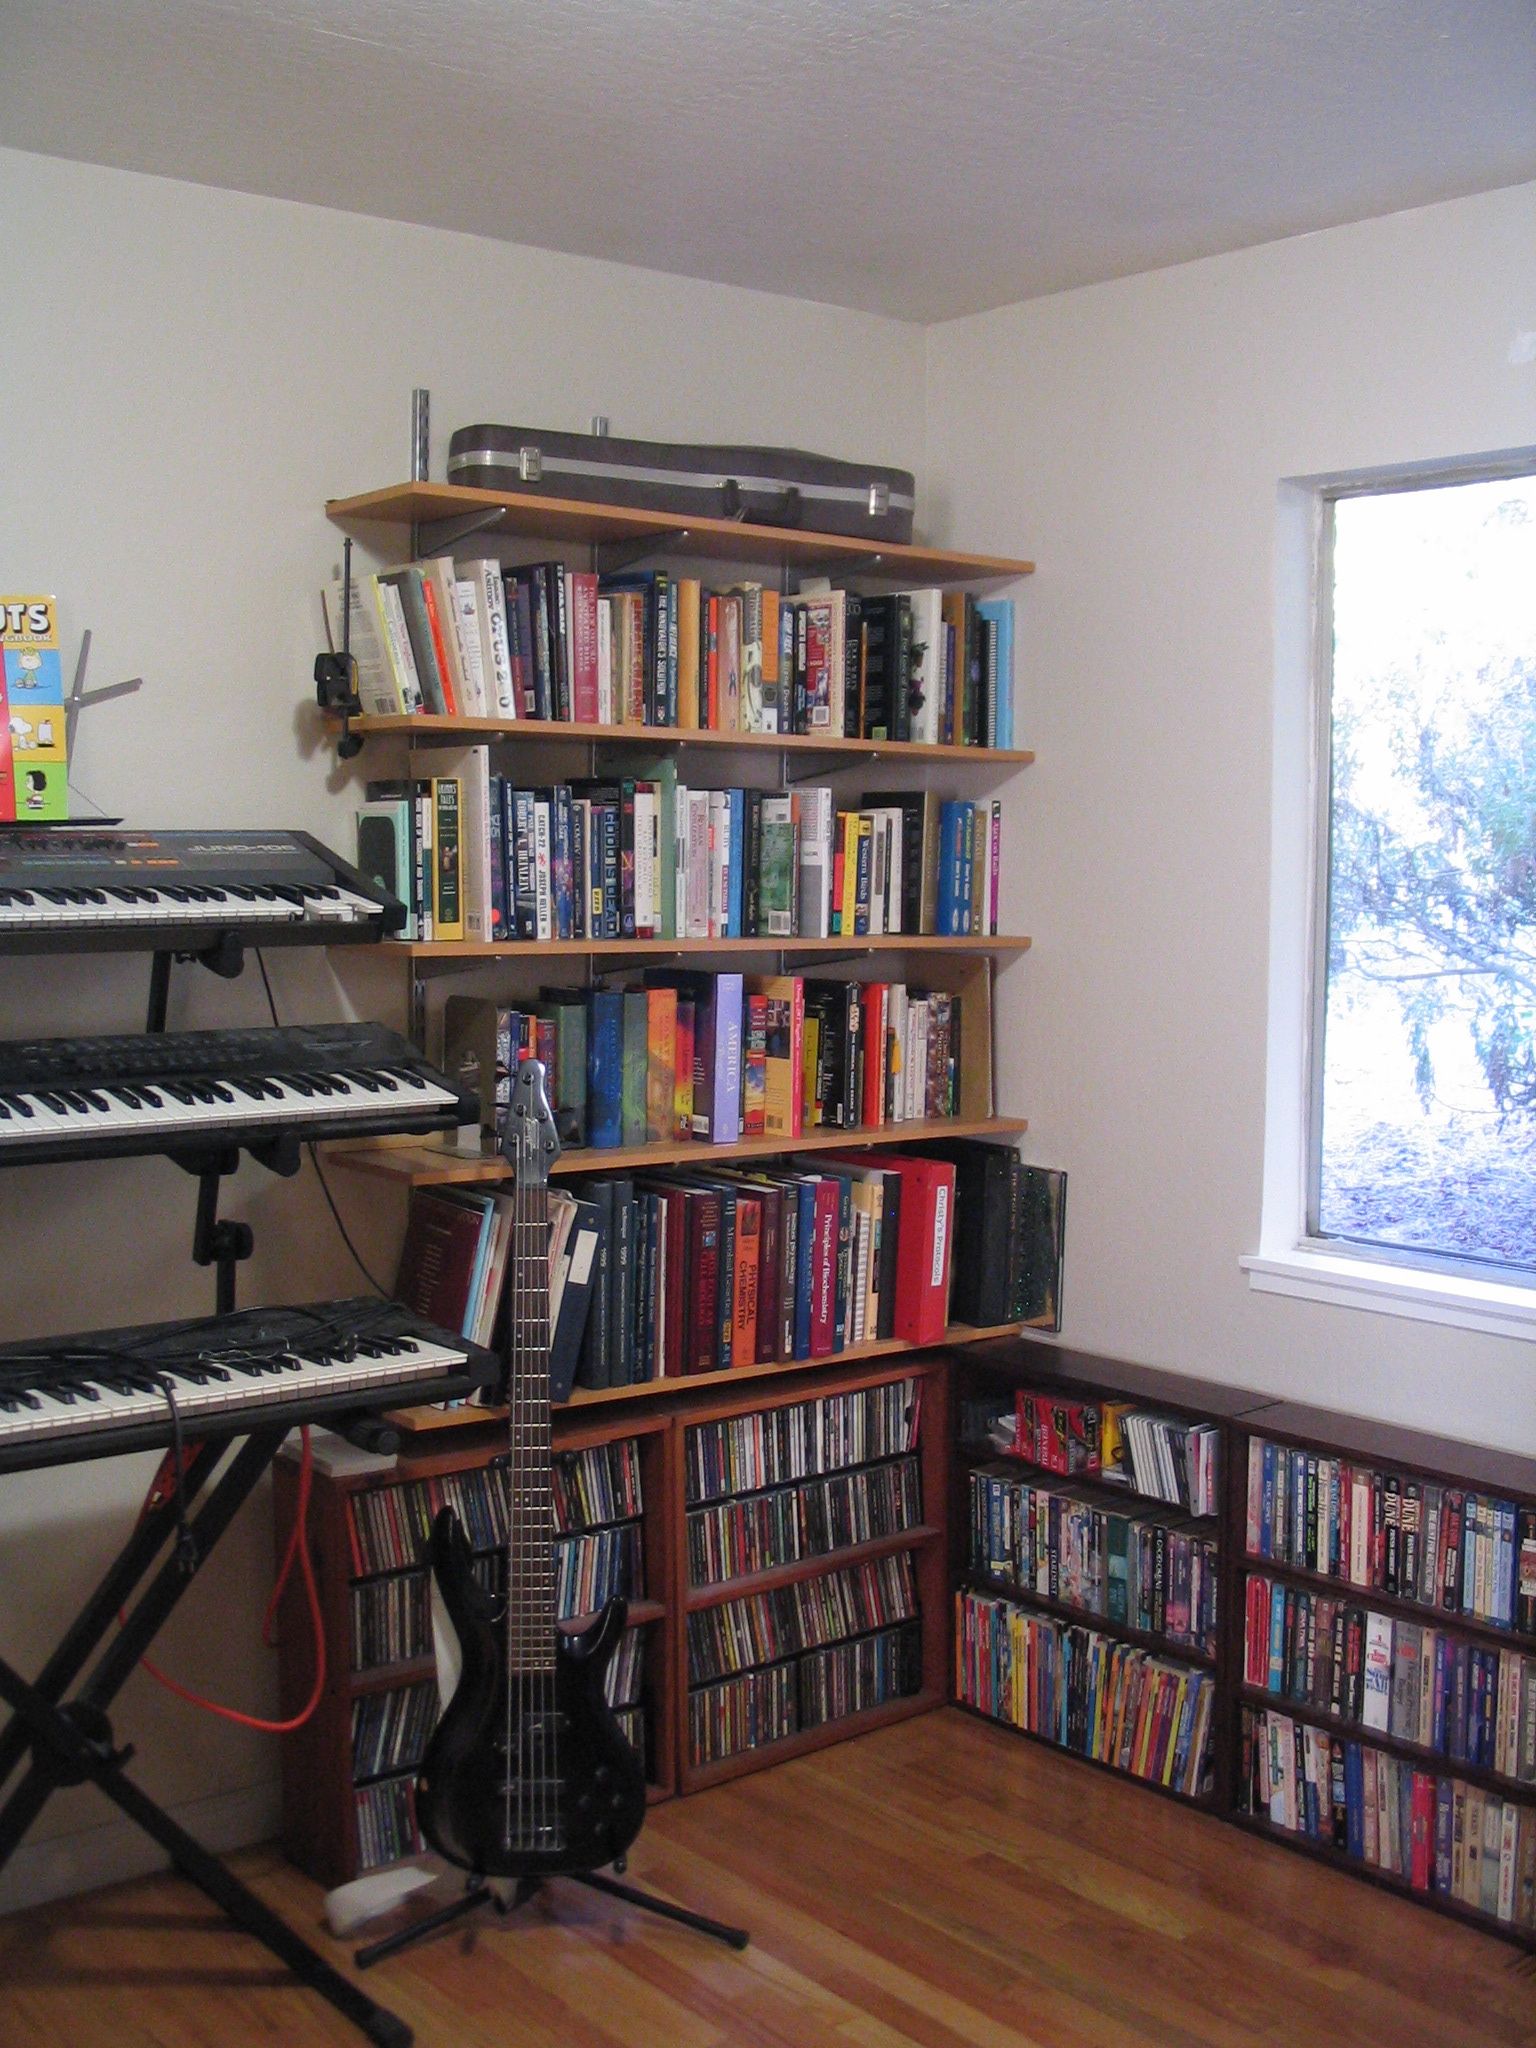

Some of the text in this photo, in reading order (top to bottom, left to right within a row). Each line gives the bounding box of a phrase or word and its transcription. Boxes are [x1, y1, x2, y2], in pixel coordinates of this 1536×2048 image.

[485, 569, 496, 610] Asimov
[493, 576, 502, 605] Isaac
[657, 594, 668, 695] THE INNOVATOR'S SOLUTION
[668, 622, 677, 661] INFLUENCE
[783, 661, 791, 686] Diane
[901, 654, 909, 674] Love
[902, 676, 909, 686] of
[783, 689, 791, 717] Duane
[900, 688, 909, 719] Insects
[517, 800, 529, 834] ROBERT
[187, 843, 297, 852] JUNO-106
[518, 850, 530, 893] HEINLEIN
[538, 814, 548, 922] CATCH-22 JOSEPH HELLER
[859, 839, 870, 900] Western Birds
[726, 1020, 739, 1094] AMERICA
[620, 1206, 629, 1240] technique
[932, 1187, 947, 1284] Christy's Protocols
[619, 1246, 629, 1266] 1999
[725, 1226, 735, 1271] Microbial
[787, 1241, 797, 1285] physiology
[819, 1214, 833, 1325] Principles of Biochemistry
[737, 1260, 749, 1331] CHEMISTRY
[746, 1263, 757, 1326] PHYSICAL
[1384, 1492, 1398, 1527] DUNE
[1402, 1498, 1415, 1532] DUNE
[1050, 1549, 1058, 1595] STARDUST
[1388, 1548, 1396, 1577] HERBERT
